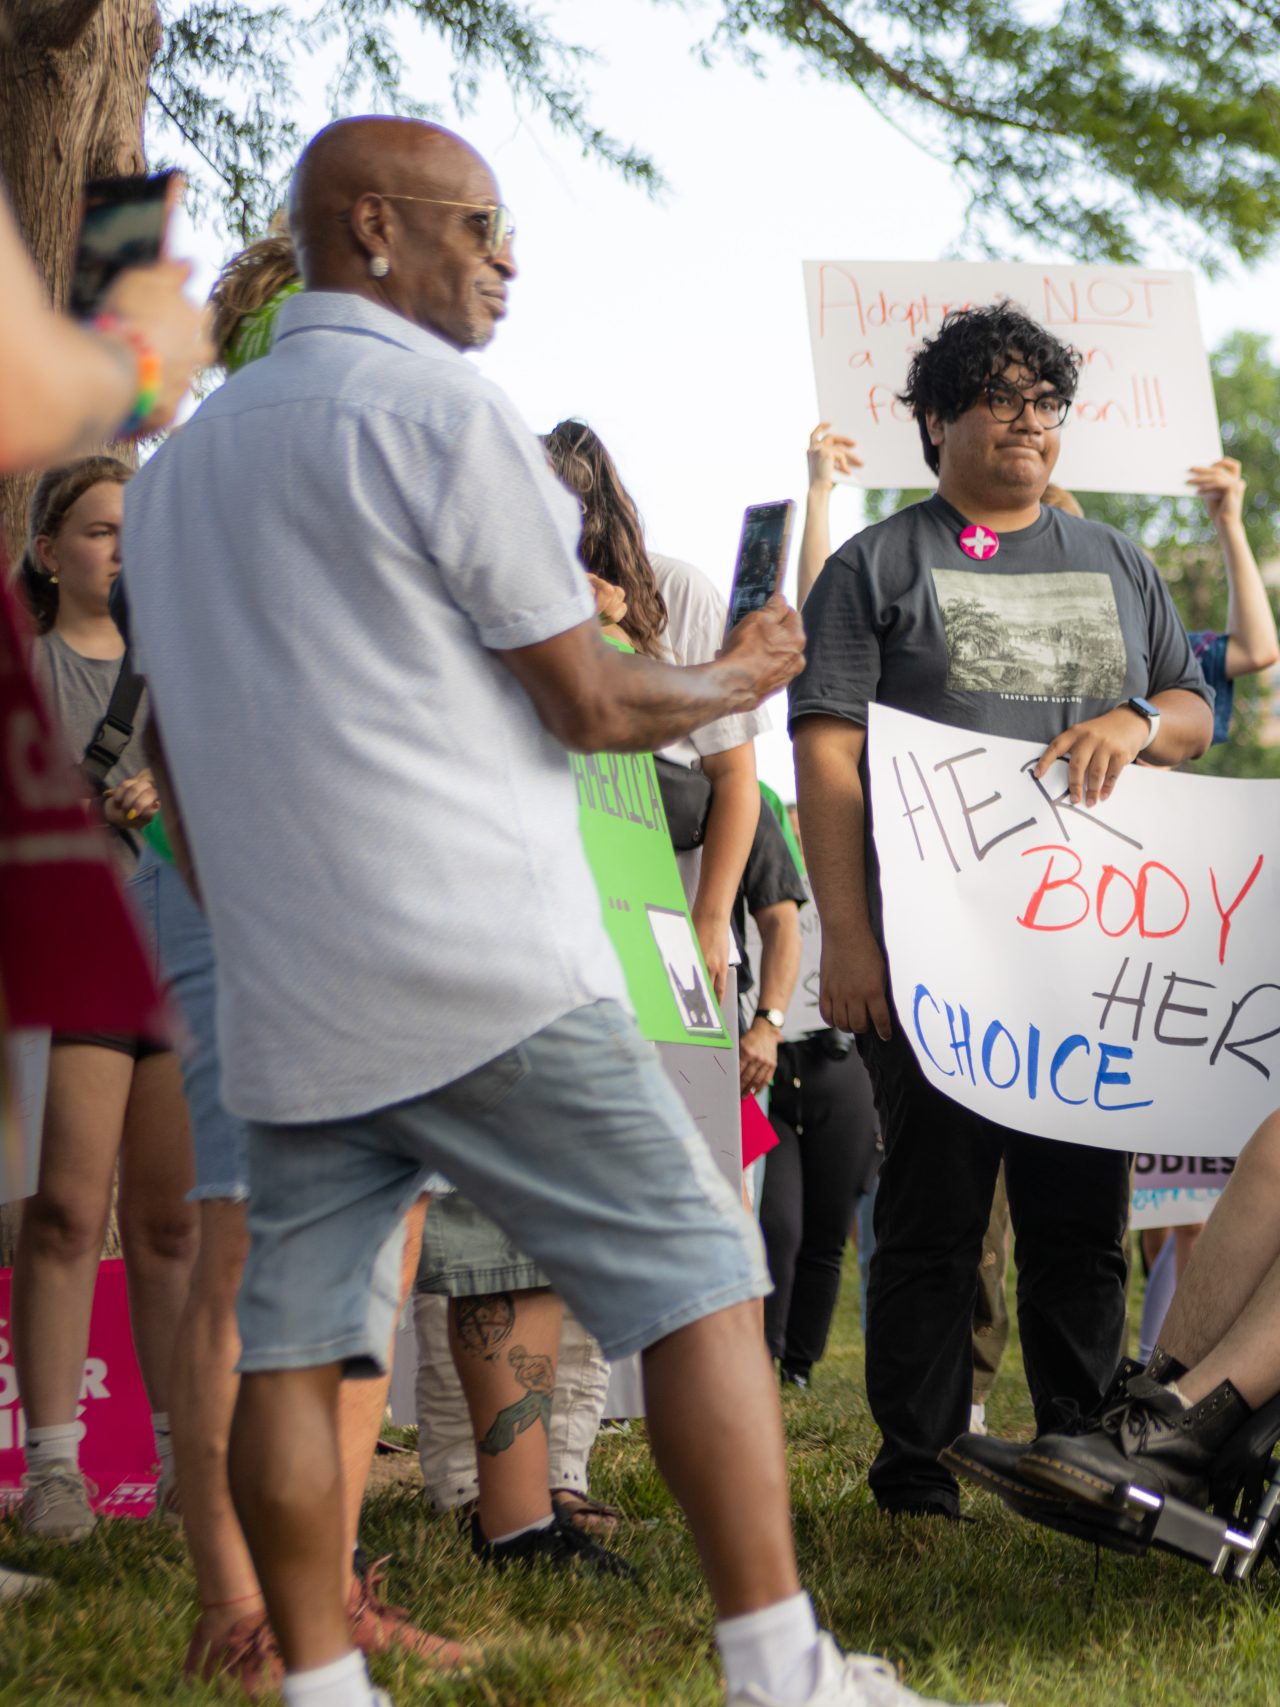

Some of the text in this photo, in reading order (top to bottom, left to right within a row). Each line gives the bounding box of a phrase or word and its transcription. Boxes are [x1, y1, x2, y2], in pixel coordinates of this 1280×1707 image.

[1043, 275, 1174, 323] NOT
[892, 747, 1143, 873] HER
[1016, 844, 1264, 965] BODY
[912, 983, 1154, 1111] CHOICE
[1135, 1152, 1237, 1175] ODIES
